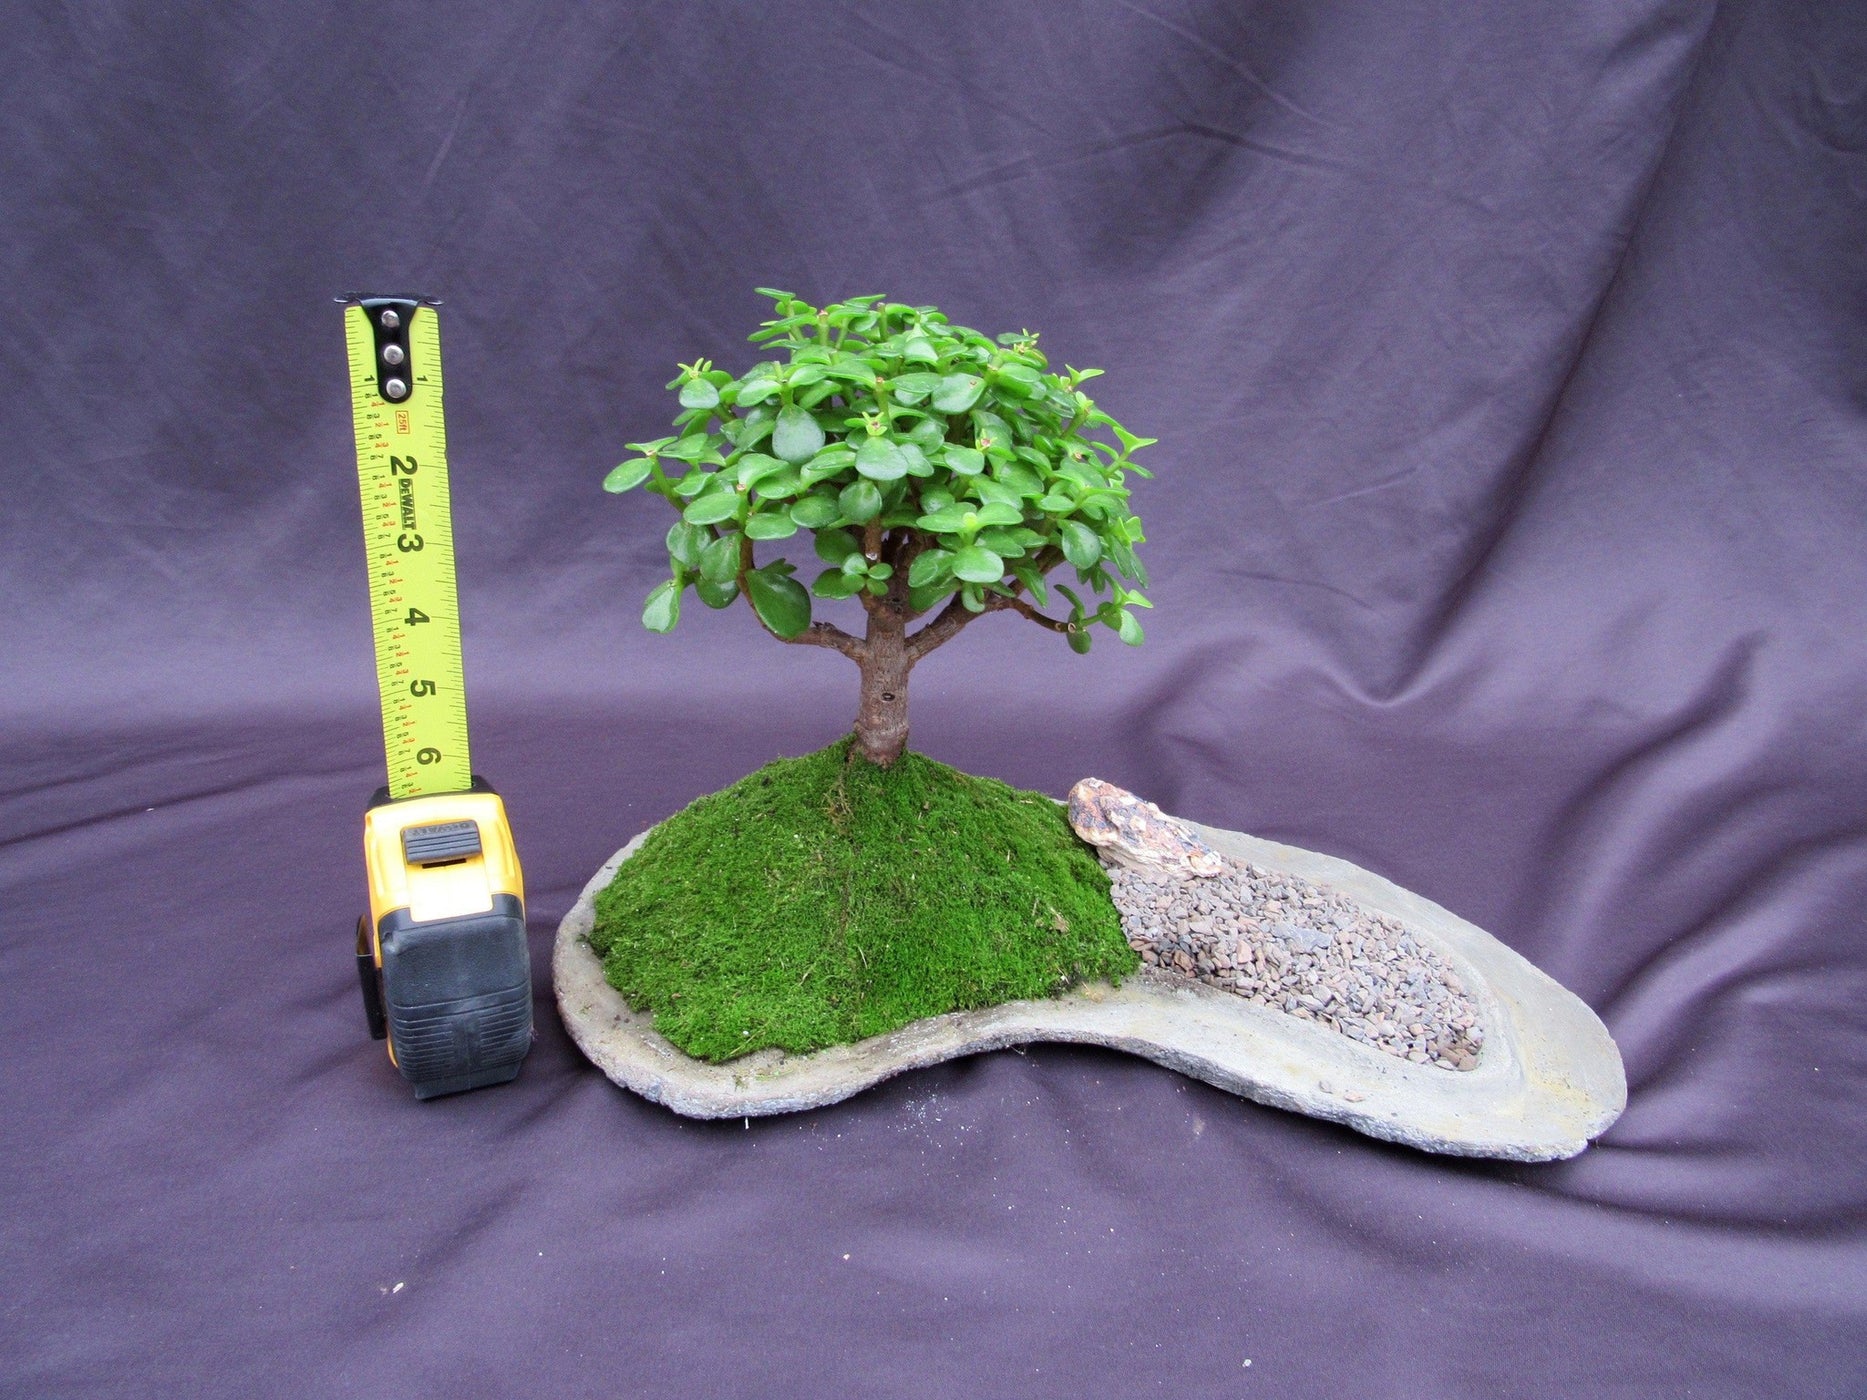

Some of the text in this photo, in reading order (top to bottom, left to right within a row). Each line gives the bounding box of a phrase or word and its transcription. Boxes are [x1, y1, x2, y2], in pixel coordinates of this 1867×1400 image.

[390, 456, 418, 476] 2
[397, 534, 424, 552] 3
[404, 608, 430, 626] 4
[410, 680, 436, 697] 5
[417, 748, 441, 765] 6
